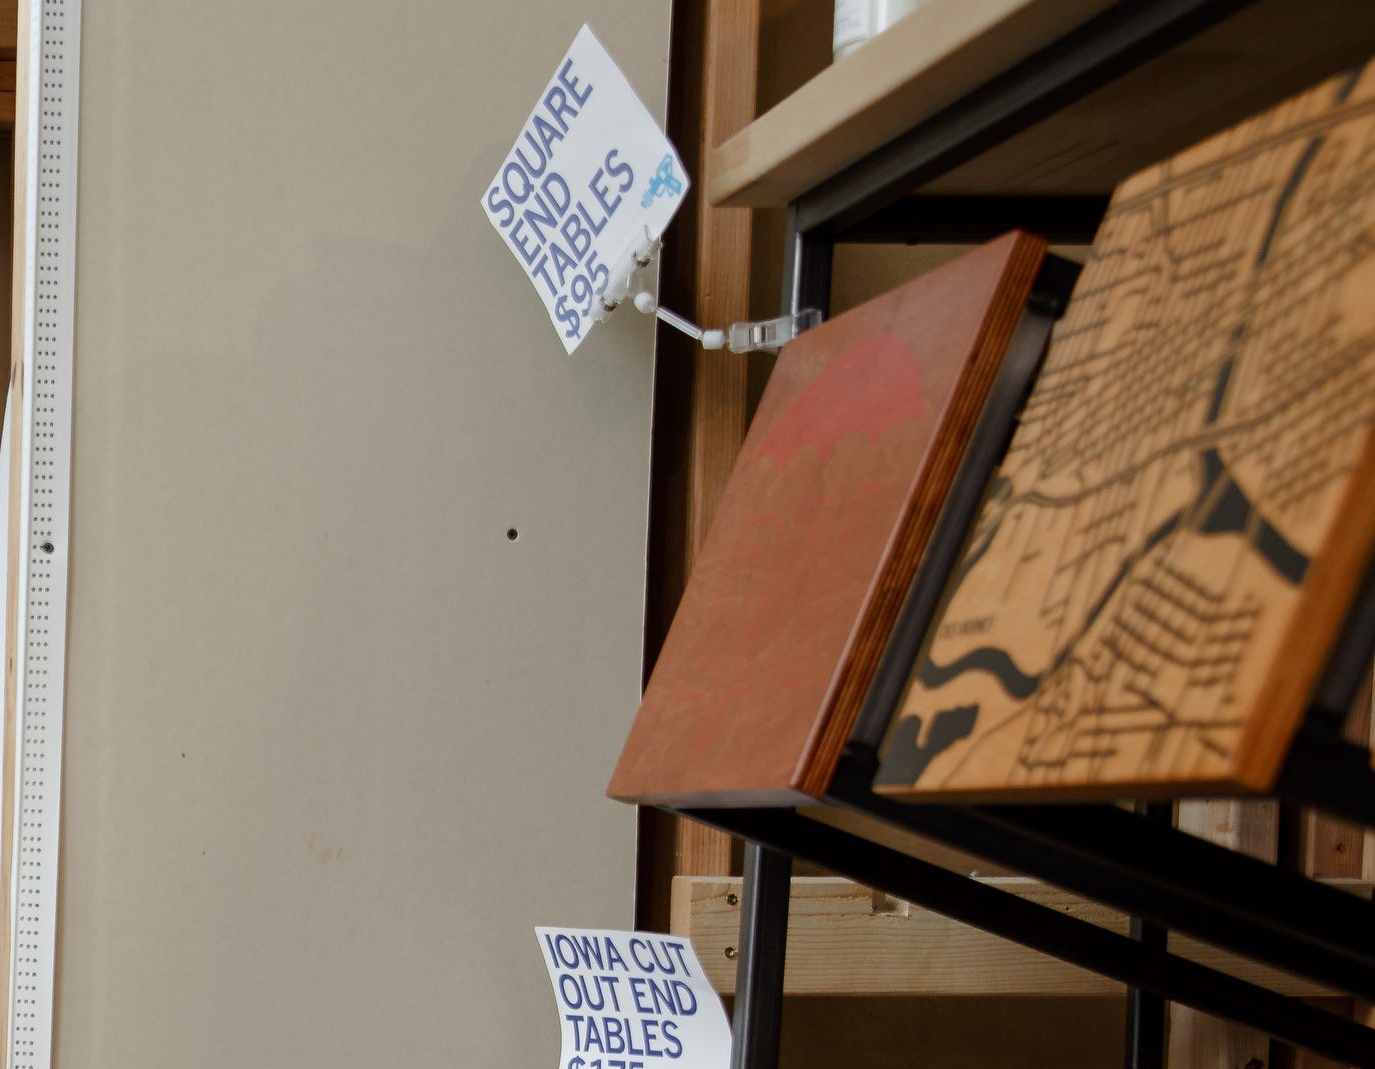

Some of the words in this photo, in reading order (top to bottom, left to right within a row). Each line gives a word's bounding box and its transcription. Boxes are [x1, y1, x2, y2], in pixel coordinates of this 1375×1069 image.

[488, 58, 593, 228] SQUARE
[509, 172, 571, 267] END
[532, 149, 634, 298] TABLES
[555, 250, 609, 340] $95
[545, 934, 629, 972] IOWA
[629, 938, 691, 977] CUT
[559, 974, 620, 1012] OUT
[629, 977, 697, 1016] END
[565, 1014, 683, 1059] TABLES
